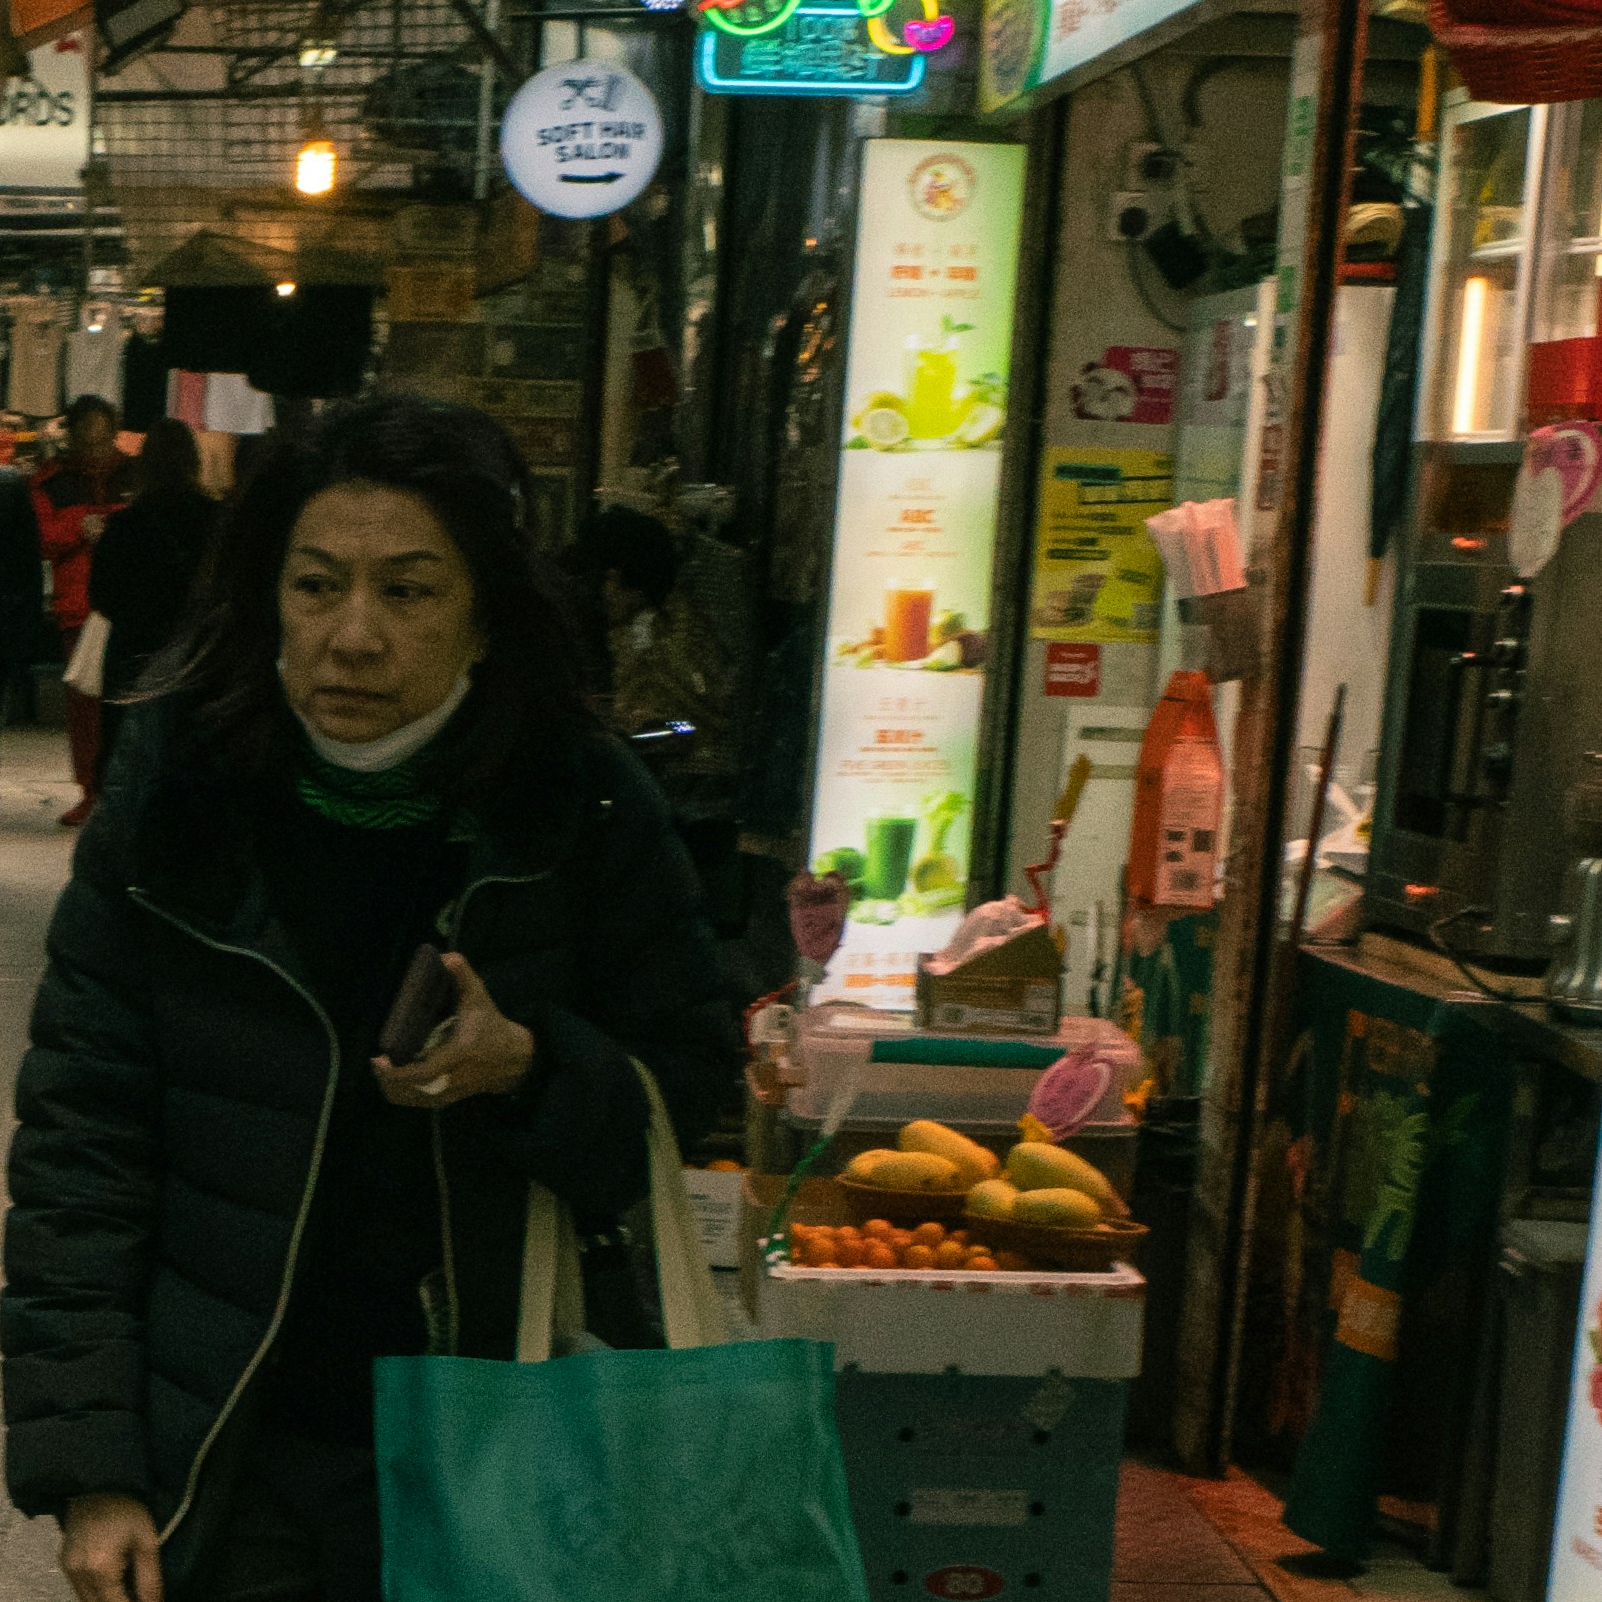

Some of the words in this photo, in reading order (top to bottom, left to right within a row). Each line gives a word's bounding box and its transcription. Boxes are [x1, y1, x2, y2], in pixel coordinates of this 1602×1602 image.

[536, 121, 594, 145] SOFT
[600, 121, 645, 139] HAIR
[555, 142, 629, 162] SALON
